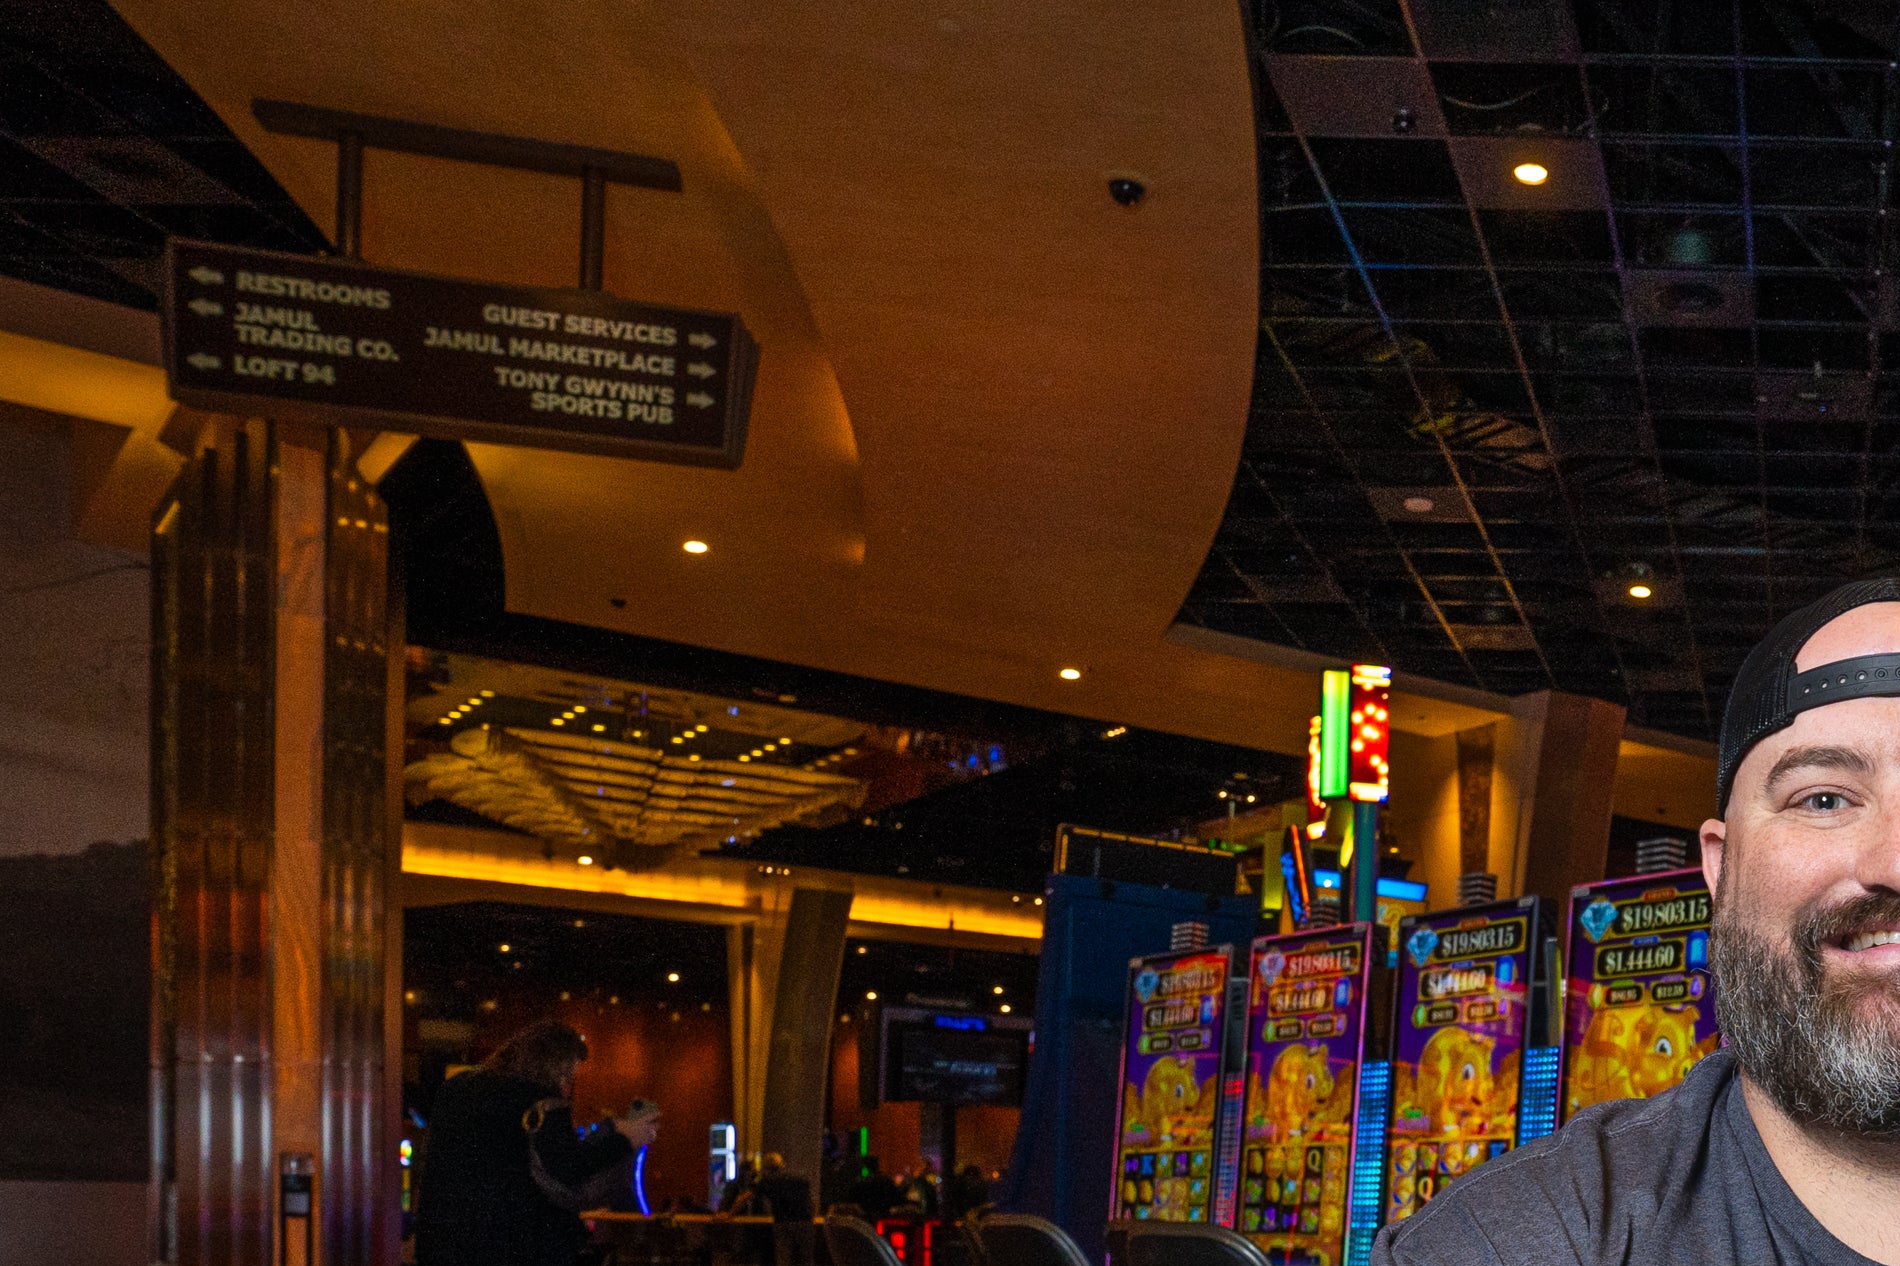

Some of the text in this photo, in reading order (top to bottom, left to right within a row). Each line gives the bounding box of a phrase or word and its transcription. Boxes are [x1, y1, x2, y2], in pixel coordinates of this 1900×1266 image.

[236, 271, 391, 310] RESTROOMS
[235, 304, 319, 333] JAMUL
[483, 305, 677, 346] GUEST SERVICES
[235, 324, 399, 361] TRADING CO.
[424, 328, 676, 377] JAMUL MARKETPLACE
[235, 356, 335, 385] LOFT 94
[496, 366, 676, 405] TONY GWYNN'S
[531, 391, 674, 425] SPORTS PUB
